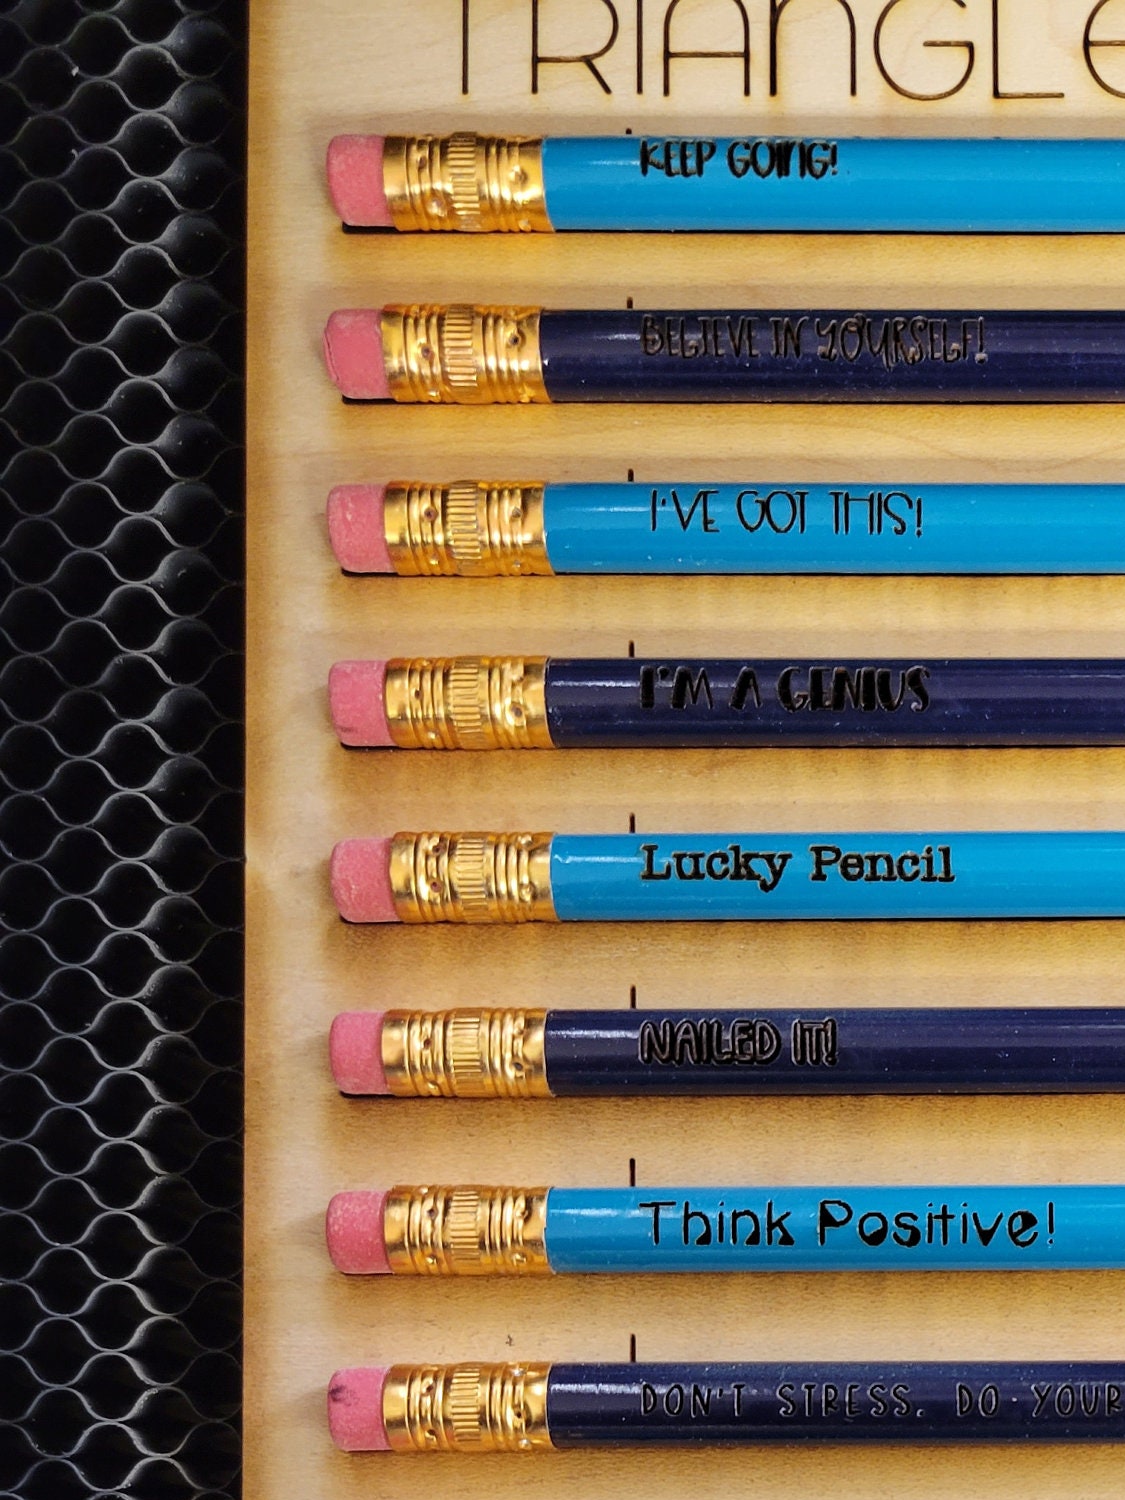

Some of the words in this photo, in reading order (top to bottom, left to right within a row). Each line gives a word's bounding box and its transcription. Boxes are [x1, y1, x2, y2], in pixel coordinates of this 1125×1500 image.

[639, 138, 716, 177] KEEP
[726, 138, 838, 178] GOING!
[639, 313, 761, 360] BELIEVE
[769, 315, 808, 358] IN
[814, 313, 988, 370] YOURSELF!
[650, 489, 720, 533] I'VE
[736, 489, 809, 534] GOT
[828, 490, 923, 538] THIS!
[639, 664, 714, 711] I'M
[728, 665, 762, 711] A
[775, 664, 931, 713] GENIUS
[640, 844, 792, 893] Lucky
[809, 845, 956, 883] Pencil
[638, 1018, 782, 1066] NAILED
[790, 1018, 839, 1066] IT!
[639, 1200, 795, 1246] Think
[816, 1199, 1055, 1248] Positive!
[640, 1382, 745, 1418] DON'T
[779, 1382, 925, 1418] STRESS.
[956, 1382, 999, 1417] DO
[1030, 1383, 1122, 1418] YOUR
